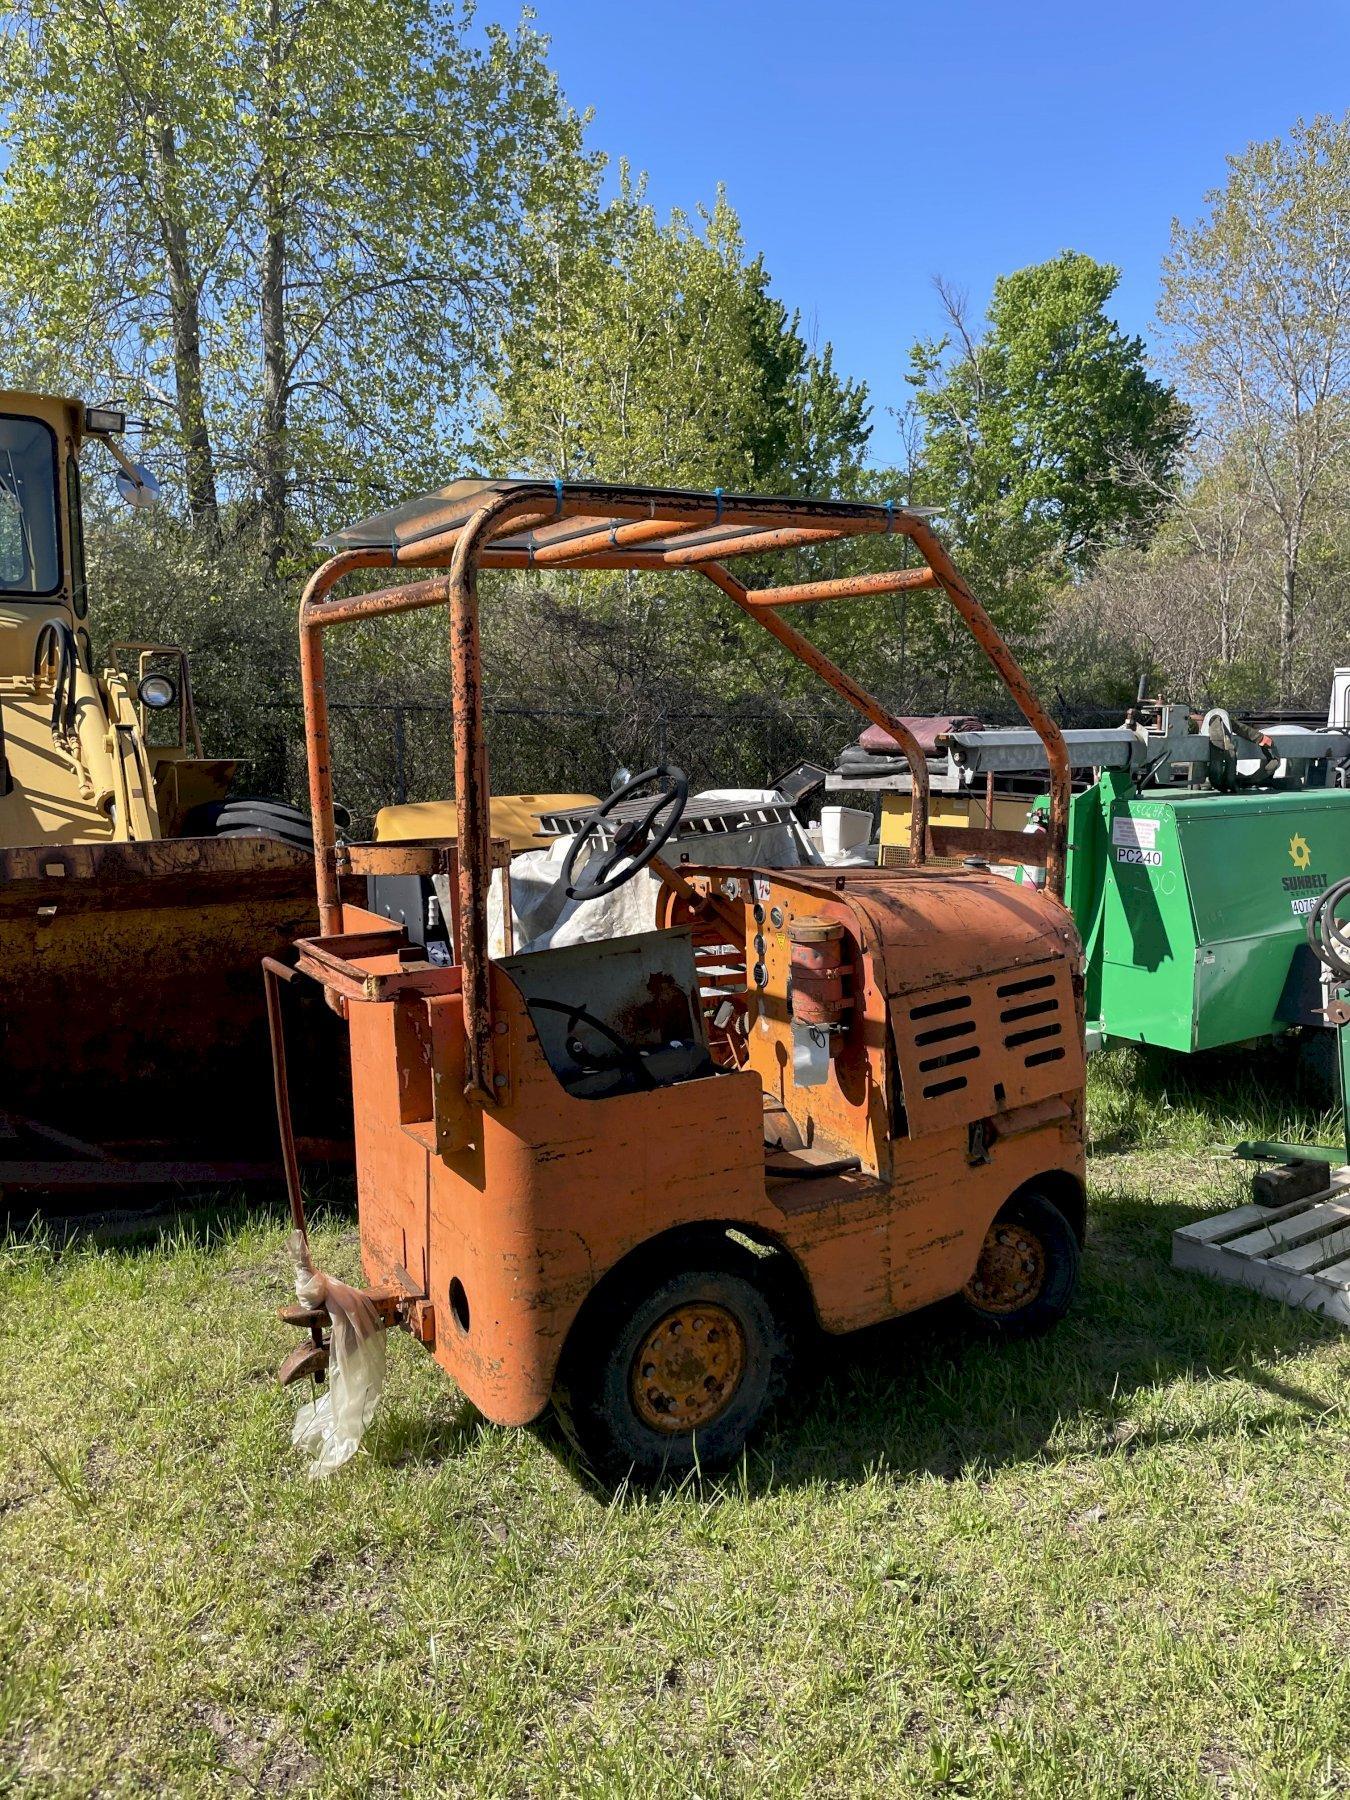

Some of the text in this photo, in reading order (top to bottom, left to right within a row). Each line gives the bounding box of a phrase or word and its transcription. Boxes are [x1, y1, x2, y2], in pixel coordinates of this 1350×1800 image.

[1118, 848, 1161, 865] PC240
[1281, 873, 1328, 891] SUNBELT
[1293, 897, 1327, 913] 4076
